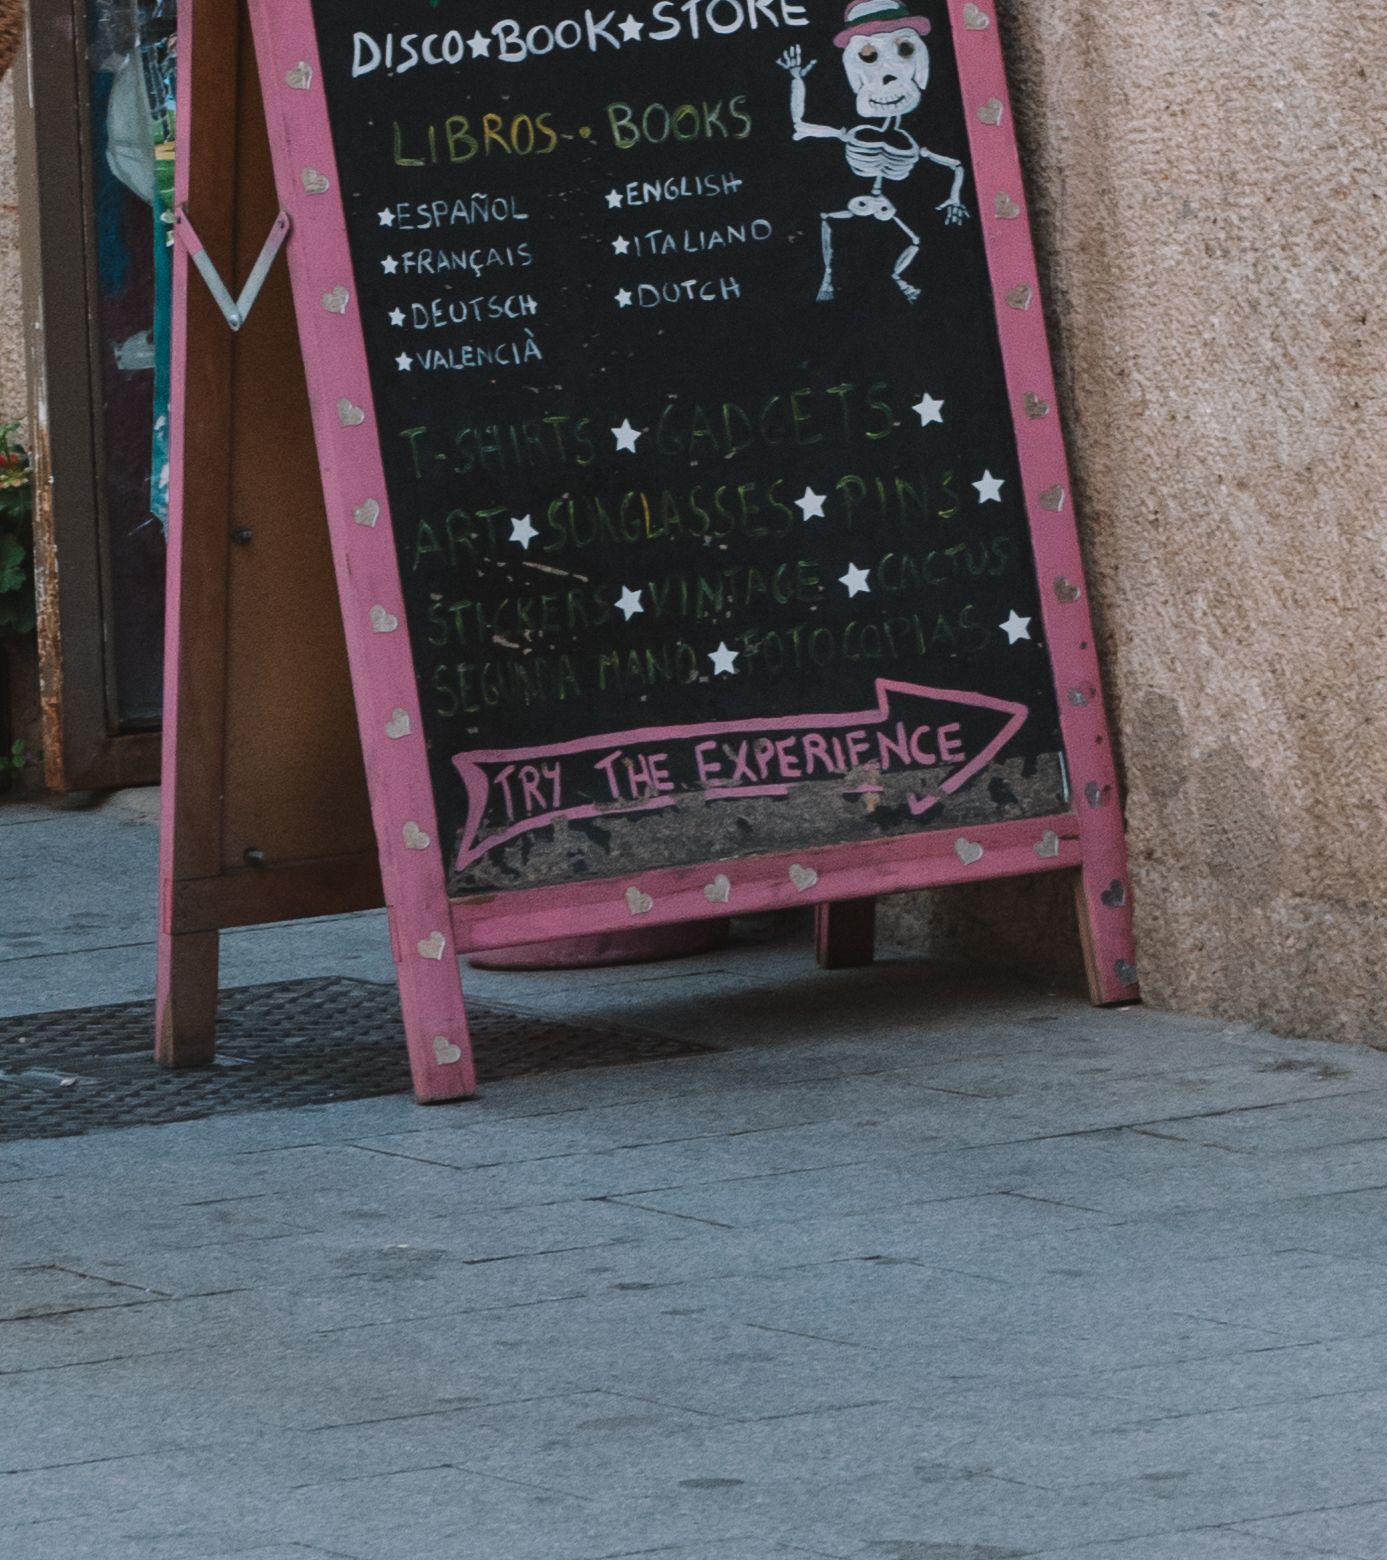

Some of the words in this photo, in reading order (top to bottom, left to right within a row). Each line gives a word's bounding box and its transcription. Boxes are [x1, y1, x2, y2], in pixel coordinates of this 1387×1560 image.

[496, 7, 623, 62] BOOK
[393, 111, 558, 167] LIBROS
[607, 95, 752, 149] BOOKS
[627, 172, 743, 207] ENGLISH
[396, 193, 529, 230] ESPAÑOL
[634, 218, 772, 257] ITALIANO
[402, 242, 534, 278] FRANÇAIS
[412, 293, 538, 330] DEUTSCH
[637, 277, 741, 308] DUTCH
[416, 328, 543, 371] VALENCIÀ
[400, 415, 596, 479] T-SHIRTS
[656, 382, 895, 455] GADGETS
[411, 506, 506, 571] ART
[543, 478, 796, 551] SUNGLASSES
[836, 472, 961, 528] PINS
[877, 535, 1016, 592] CACTUS
[493, 760, 562, 821] TRY
[594, 751, 674, 800] THE
[696, 721, 968, 786] EXPERIENCE
